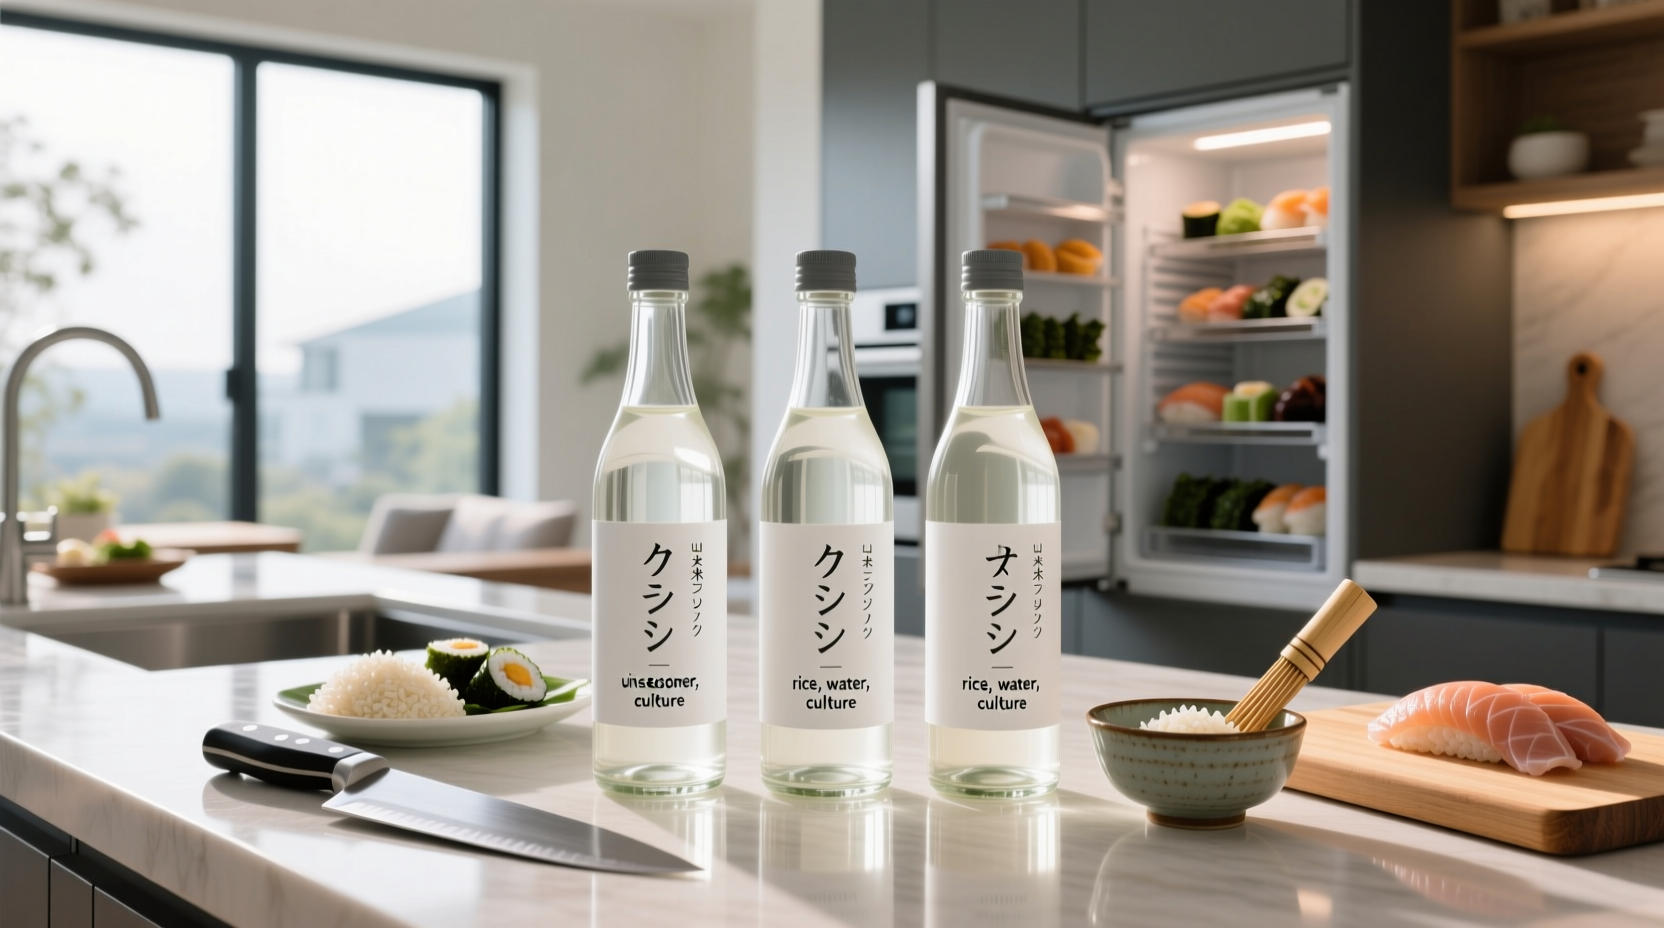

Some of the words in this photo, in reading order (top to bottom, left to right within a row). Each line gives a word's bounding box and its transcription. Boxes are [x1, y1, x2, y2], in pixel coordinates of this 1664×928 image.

[642, 542, 674, 653] クシシ
[813, 543, 846, 655] クシシ
[792, 674, 823, 694] rice,
[825, 677, 870, 693] water,
[962, 675, 994, 695] rice,
[997, 677, 1041, 693] water,
[633, 692, 686, 709] culture
[805, 694, 857, 711] culture
[977, 694, 1028, 711] culture
